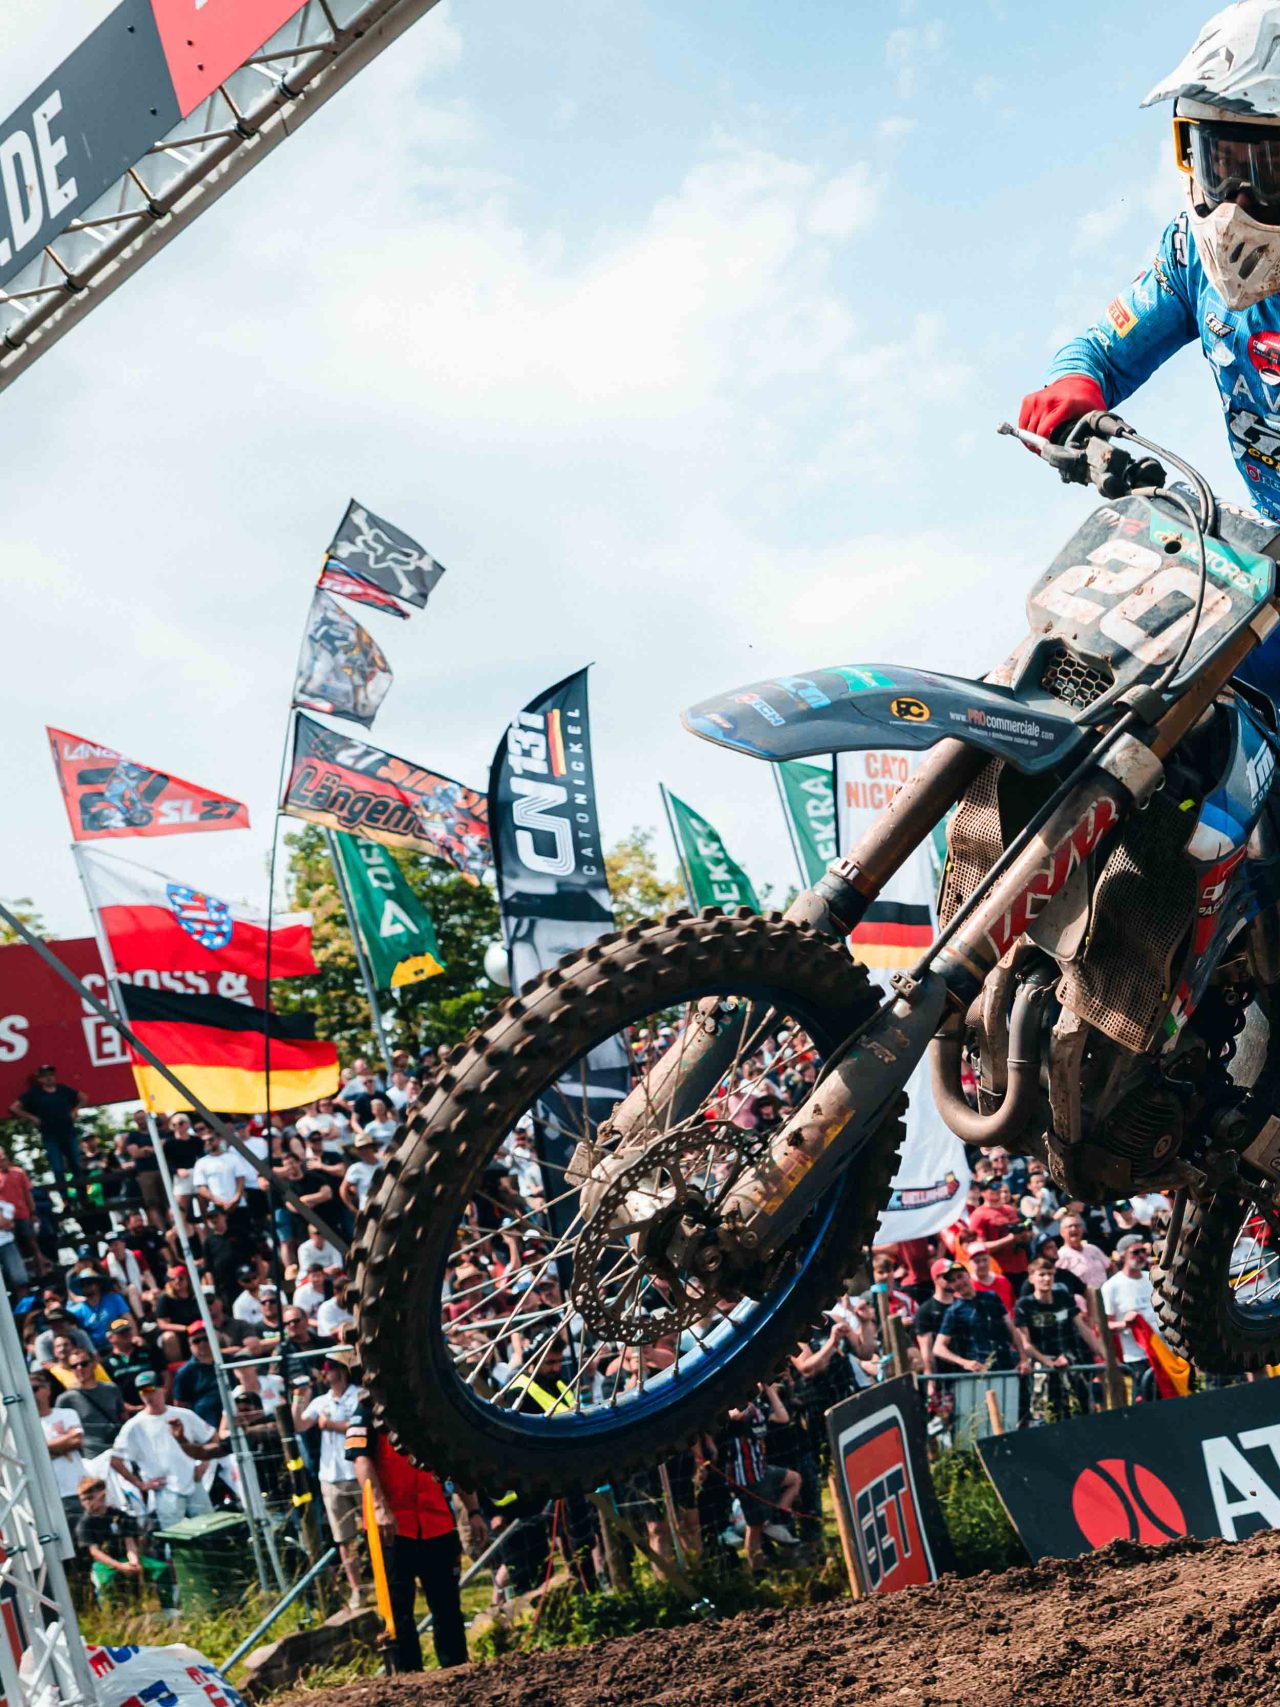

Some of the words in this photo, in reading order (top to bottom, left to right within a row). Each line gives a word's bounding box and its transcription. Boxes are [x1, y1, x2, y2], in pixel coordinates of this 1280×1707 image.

[0, 90, 78, 266] DE
[340, 738, 386, 770] 27
[800, 774, 839, 866] EKRA
